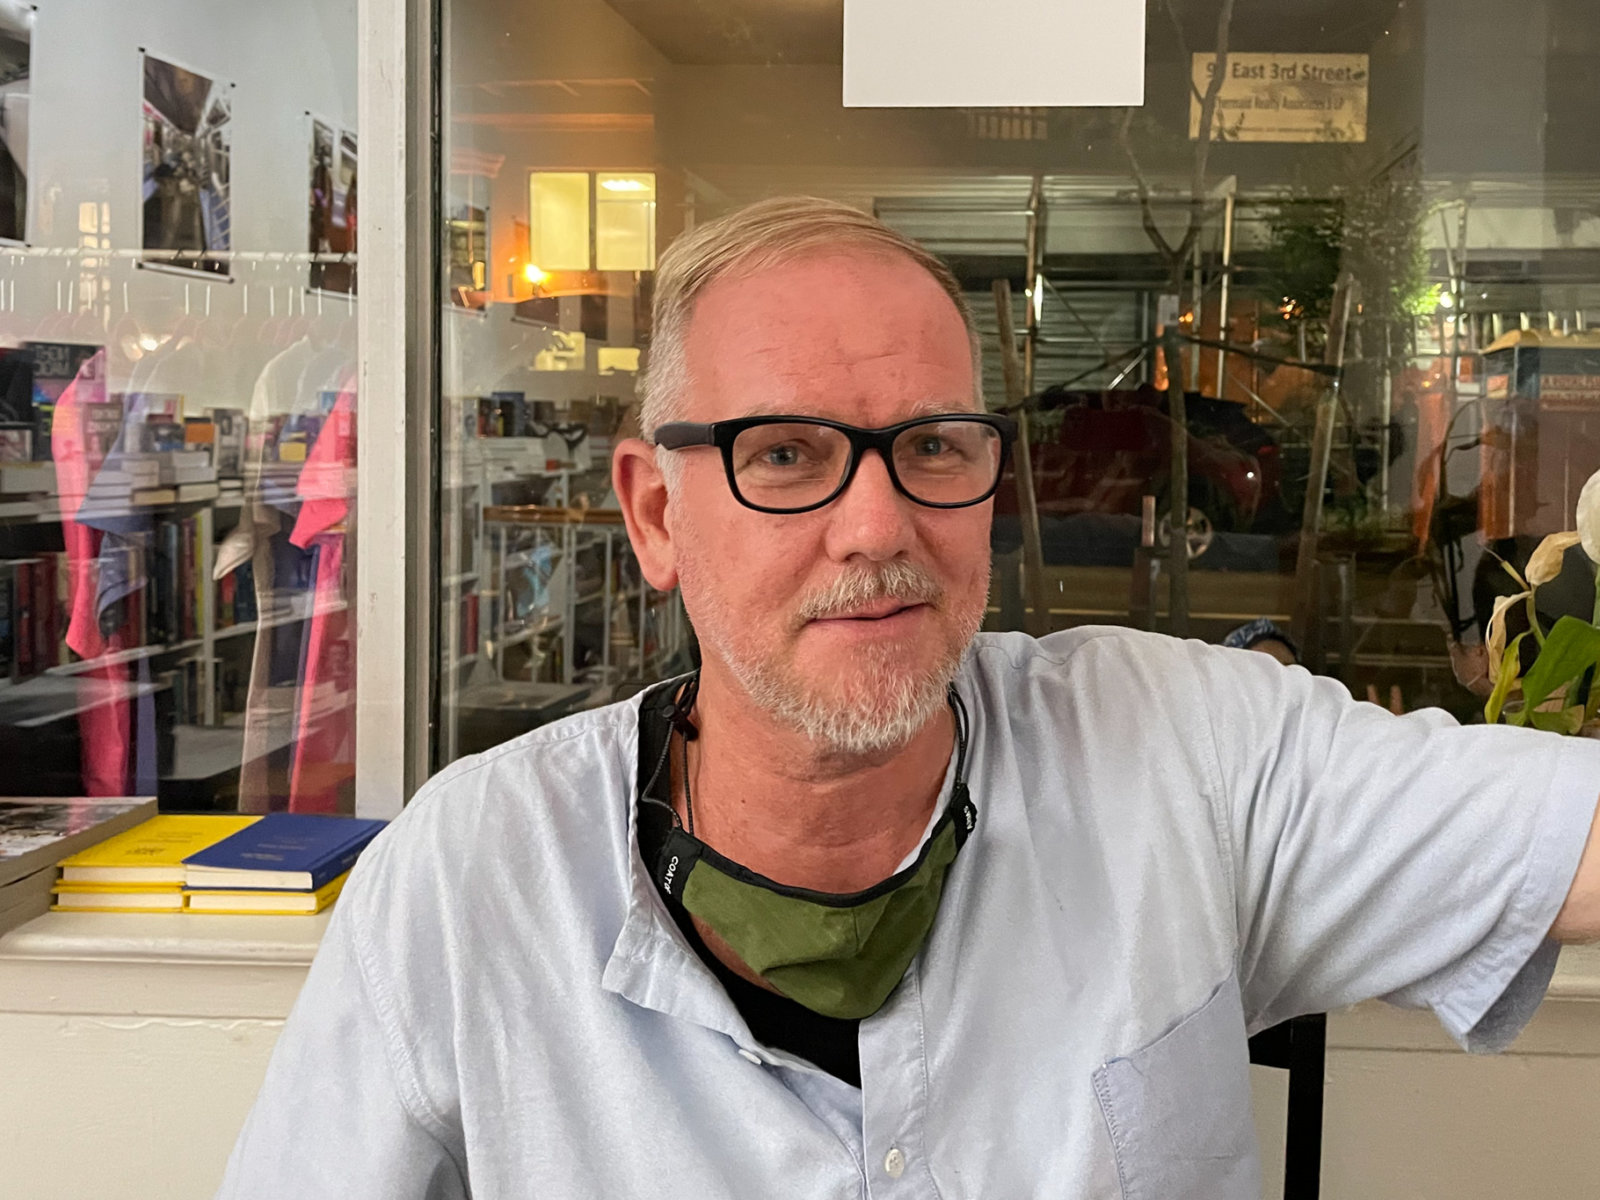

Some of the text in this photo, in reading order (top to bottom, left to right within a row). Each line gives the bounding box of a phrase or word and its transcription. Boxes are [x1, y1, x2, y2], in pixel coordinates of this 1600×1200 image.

[1232, 62, 1265, 80] East
[1271, 62, 1297, 80] 3rd
[1301, 62, 1351, 80] Street
